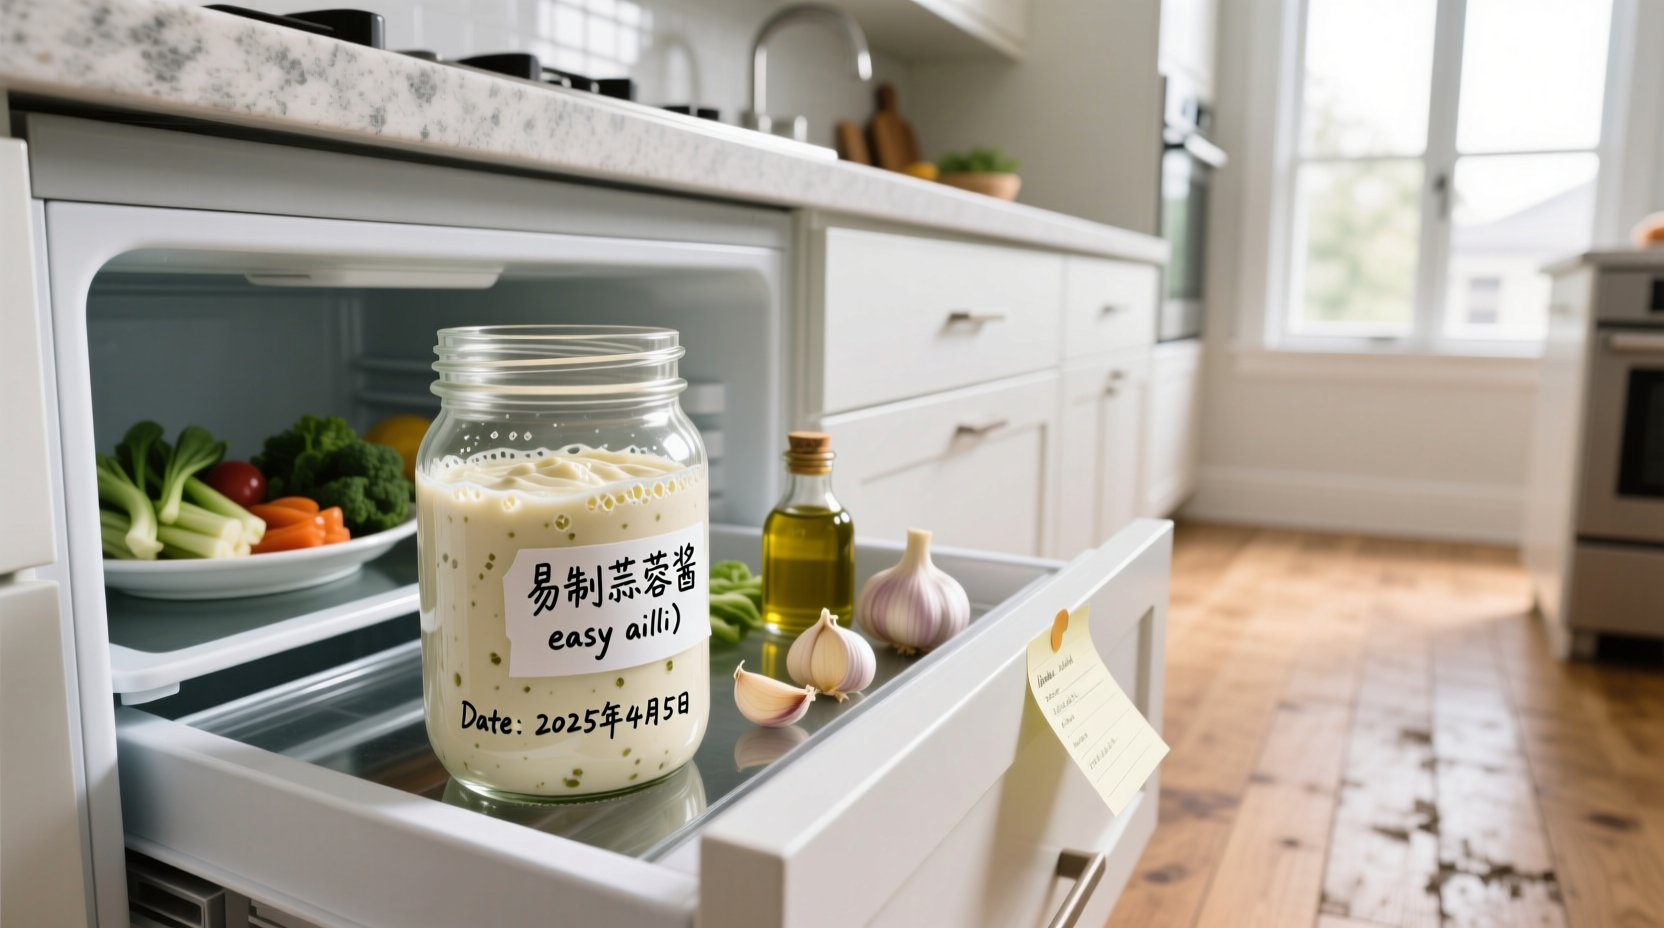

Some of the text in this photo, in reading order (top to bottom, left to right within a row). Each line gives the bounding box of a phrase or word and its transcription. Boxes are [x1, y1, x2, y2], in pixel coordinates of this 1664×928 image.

[548, 602, 681, 661] easy ailli)
[461, 691, 689, 740] Date: 2025年4月5日
